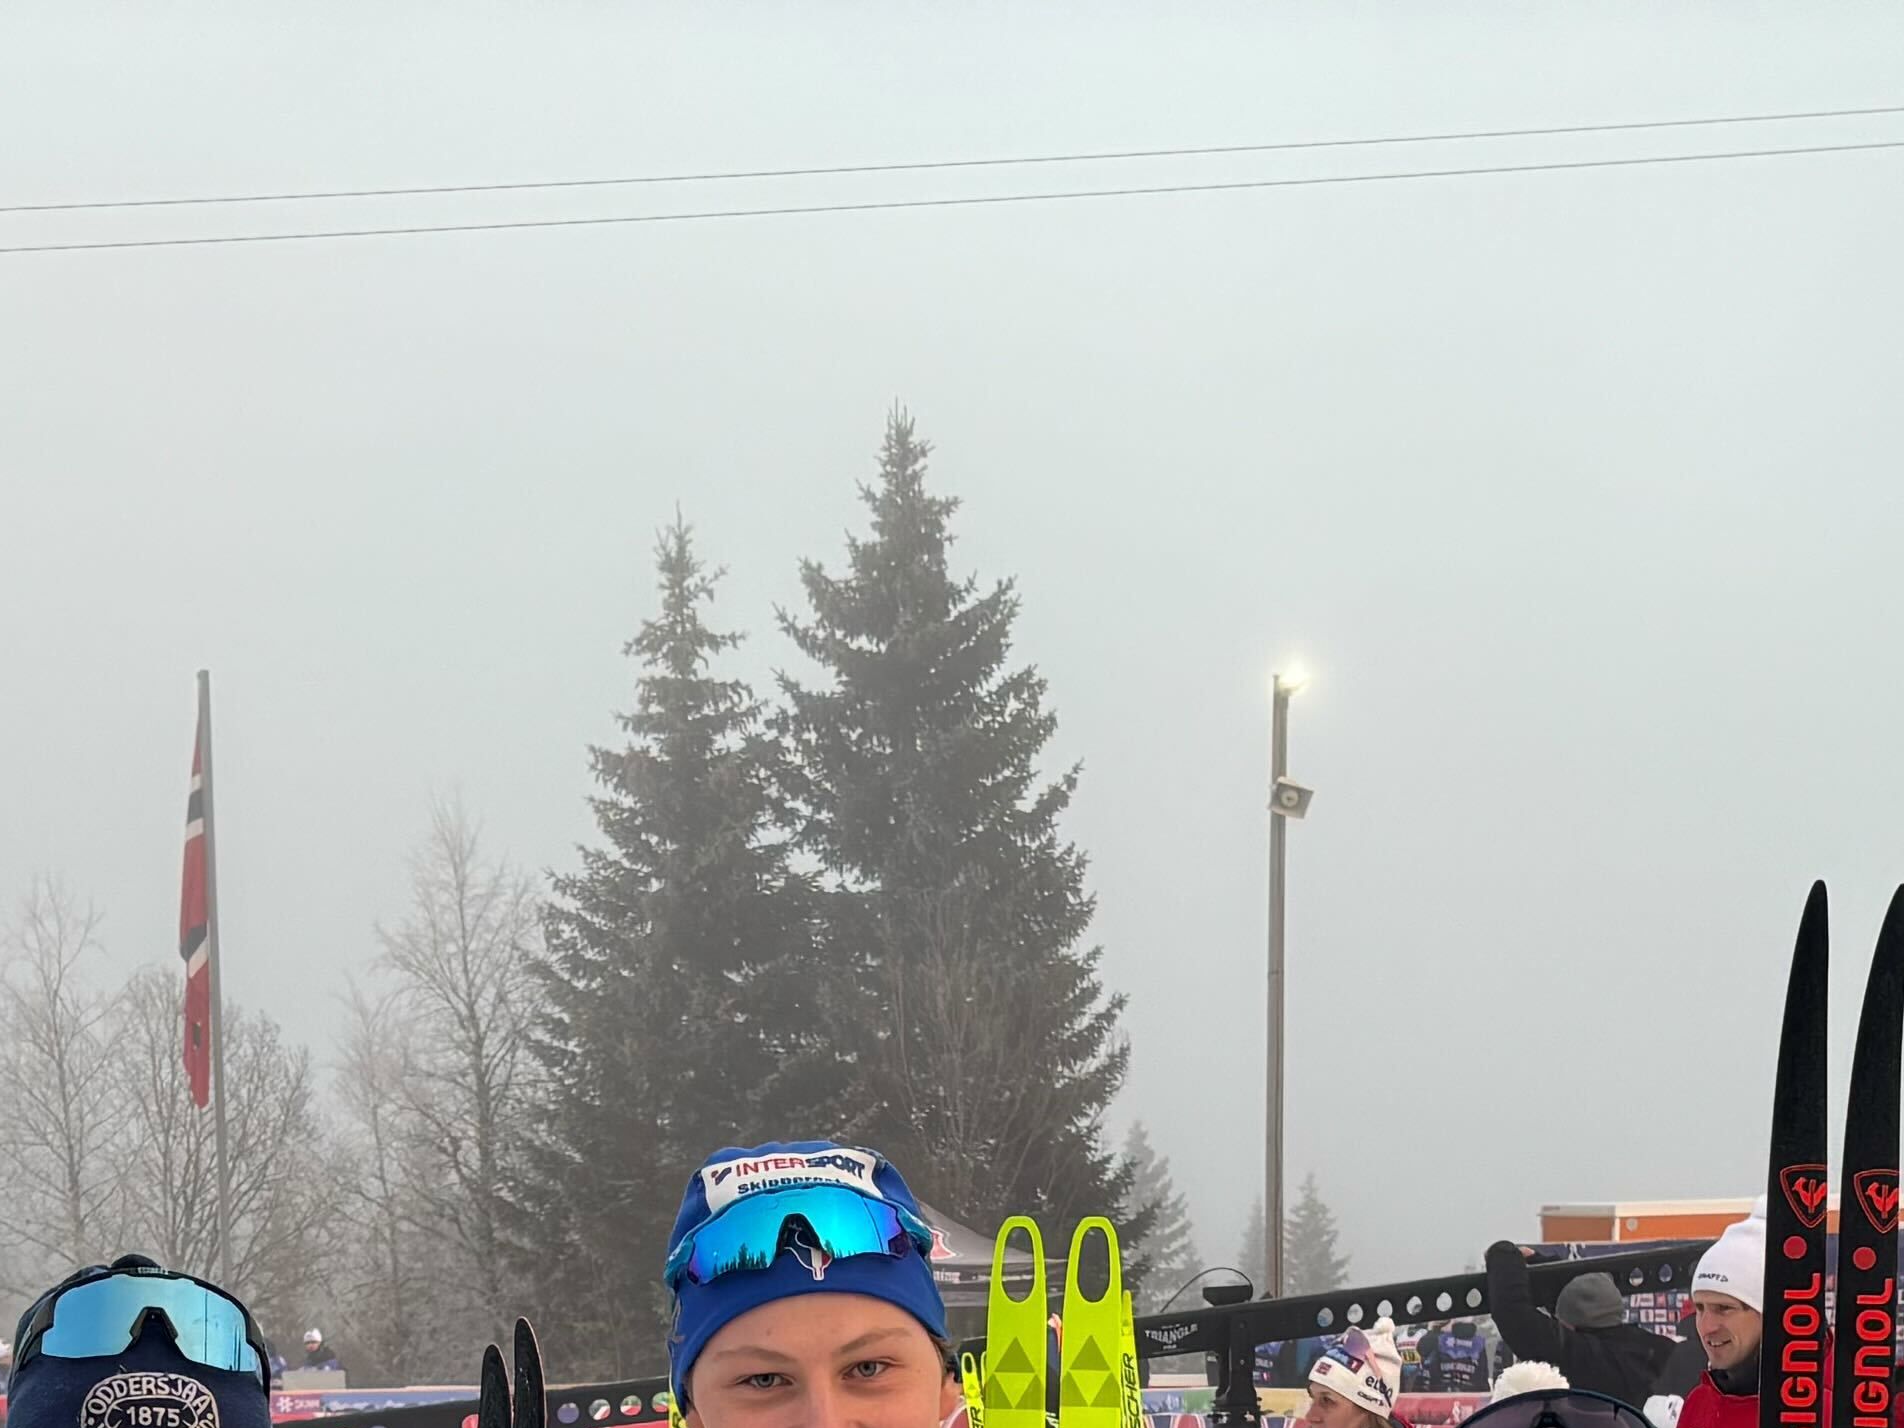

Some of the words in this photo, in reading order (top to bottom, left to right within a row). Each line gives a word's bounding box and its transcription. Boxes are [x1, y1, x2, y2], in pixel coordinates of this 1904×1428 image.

[736, 1155, 865, 1179] INTERSPORT
[1145, 1323, 1197, 1345] TRIANGLE
[88, 1377, 211, 1415] ODDERSJAA
[127, 1406, 180, 1428] 1875
